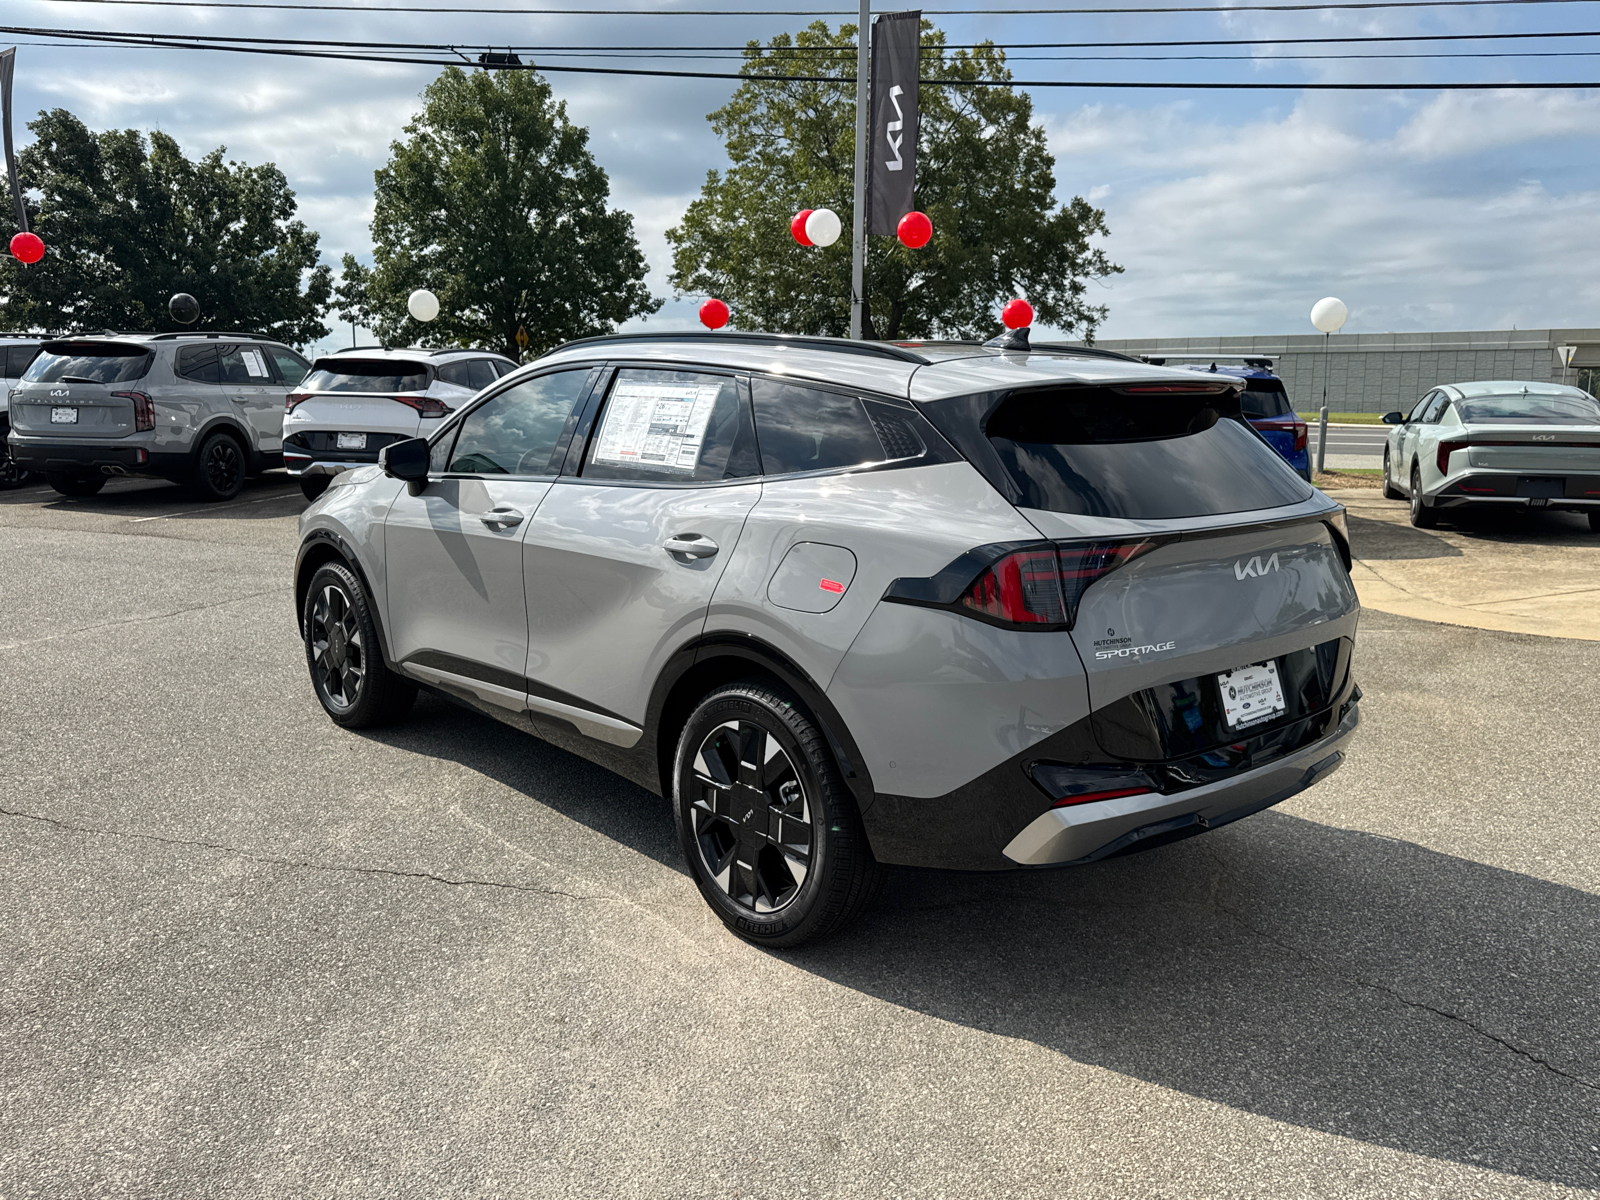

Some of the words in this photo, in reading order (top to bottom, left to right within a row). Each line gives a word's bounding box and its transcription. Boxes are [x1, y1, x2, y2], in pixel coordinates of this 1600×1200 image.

[885, 84, 904, 171] KIA
[50, 389, 70, 397] KIA
[1233, 552, 1280, 581] KIA
[1093, 636, 1132, 647] HUTCHINSON
[1095, 640, 1176, 660] SPORTAGE
[1237, 679, 1273, 696] HUTCHINSON
[1240, 692, 1261, 701] AUTOMOTIVE
[1261, 687, 1273, 697] GROUP
[743, 809, 753, 823] KIA
[736, 917, 784, 934] MICHELIN
